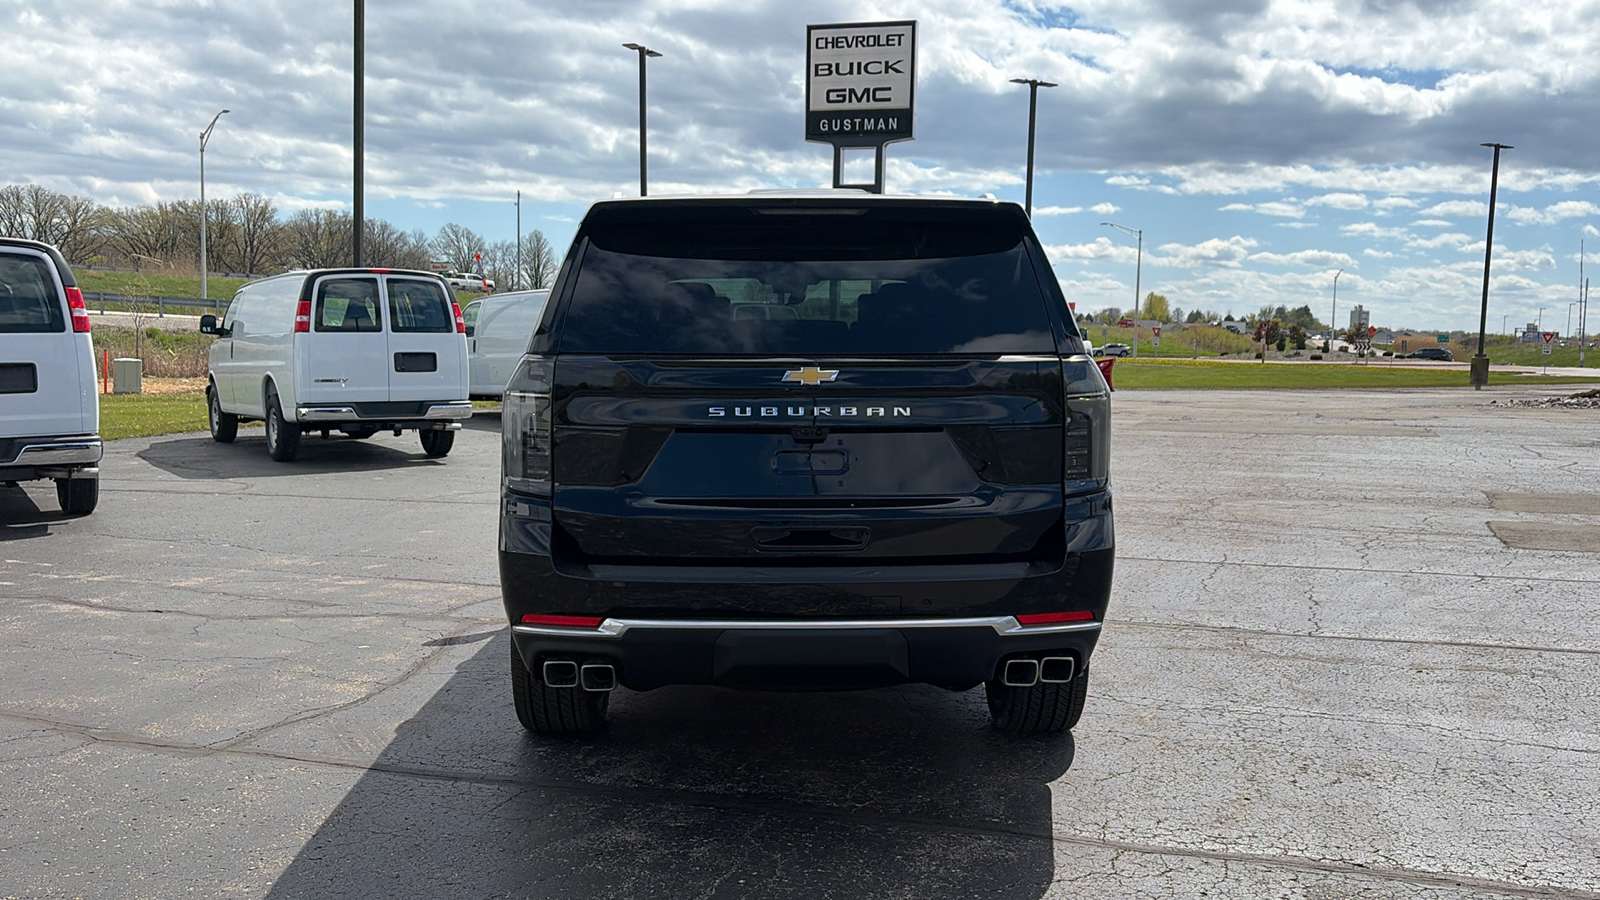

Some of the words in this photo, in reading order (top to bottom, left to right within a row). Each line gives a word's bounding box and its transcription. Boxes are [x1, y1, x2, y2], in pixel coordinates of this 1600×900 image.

[815, 33, 905, 50] CHEVROLET
[814, 59, 905, 77] BUICK
[825, 86, 892, 104] GMC
[819, 117, 898, 132] GUSTMAN
[708, 406, 911, 417] SUBURBAN
